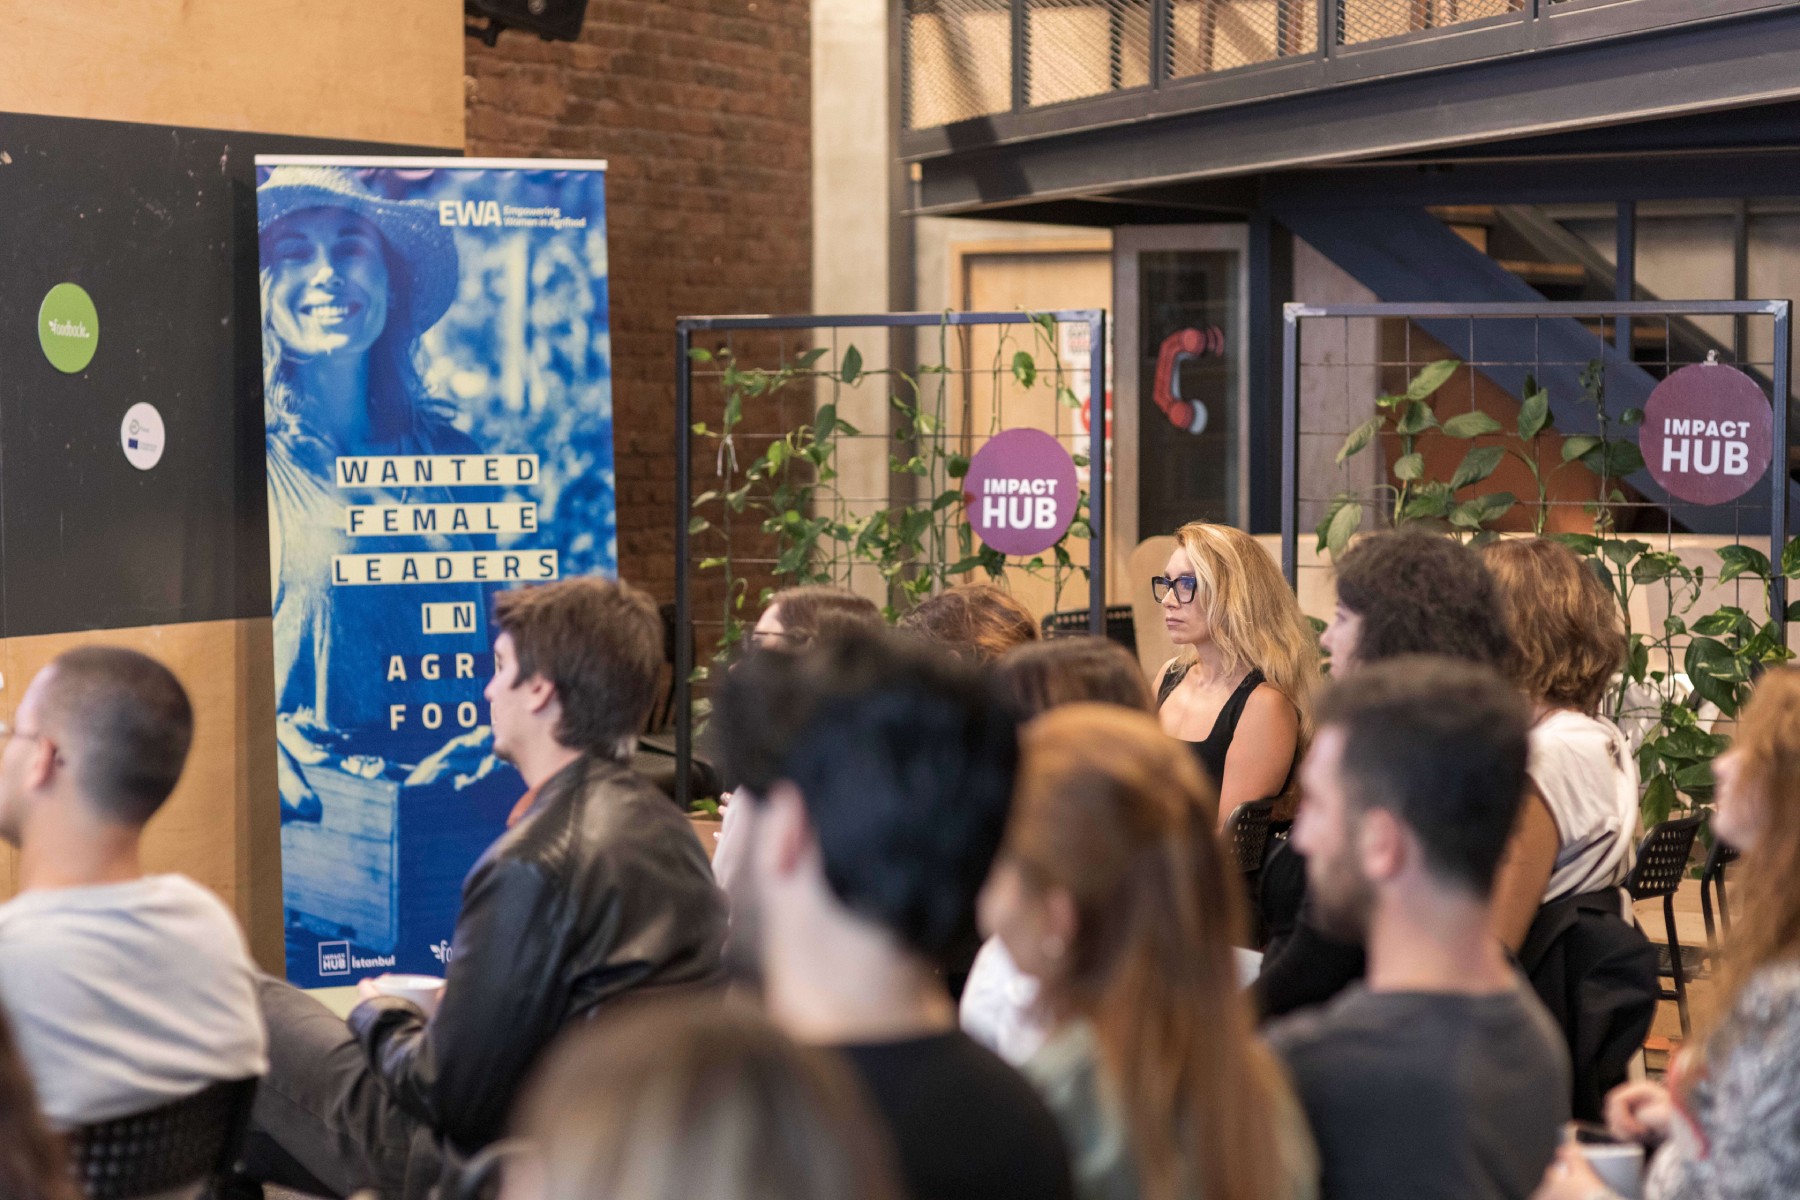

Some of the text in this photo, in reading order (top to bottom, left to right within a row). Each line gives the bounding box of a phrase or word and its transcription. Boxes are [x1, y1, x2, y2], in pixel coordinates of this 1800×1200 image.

[439, 200, 502, 227] EWA
[503, 205, 561, 218] Empowering
[1664, 418, 1750, 439] IMPACT
[1662, 437, 1749, 476] HUB
[340, 458, 534, 483] WANTED
[983, 478, 1058, 496] IMPACT
[350, 506, 535, 533] FEMALE
[982, 496, 1058, 529] HUB
[335, 554, 555, 583] LEADERS
[425, 605, 472, 630] IN
[387, 652, 476, 682] AGR
[390, 701, 478, 731] FOO
[323, 959, 347, 970] HUB
